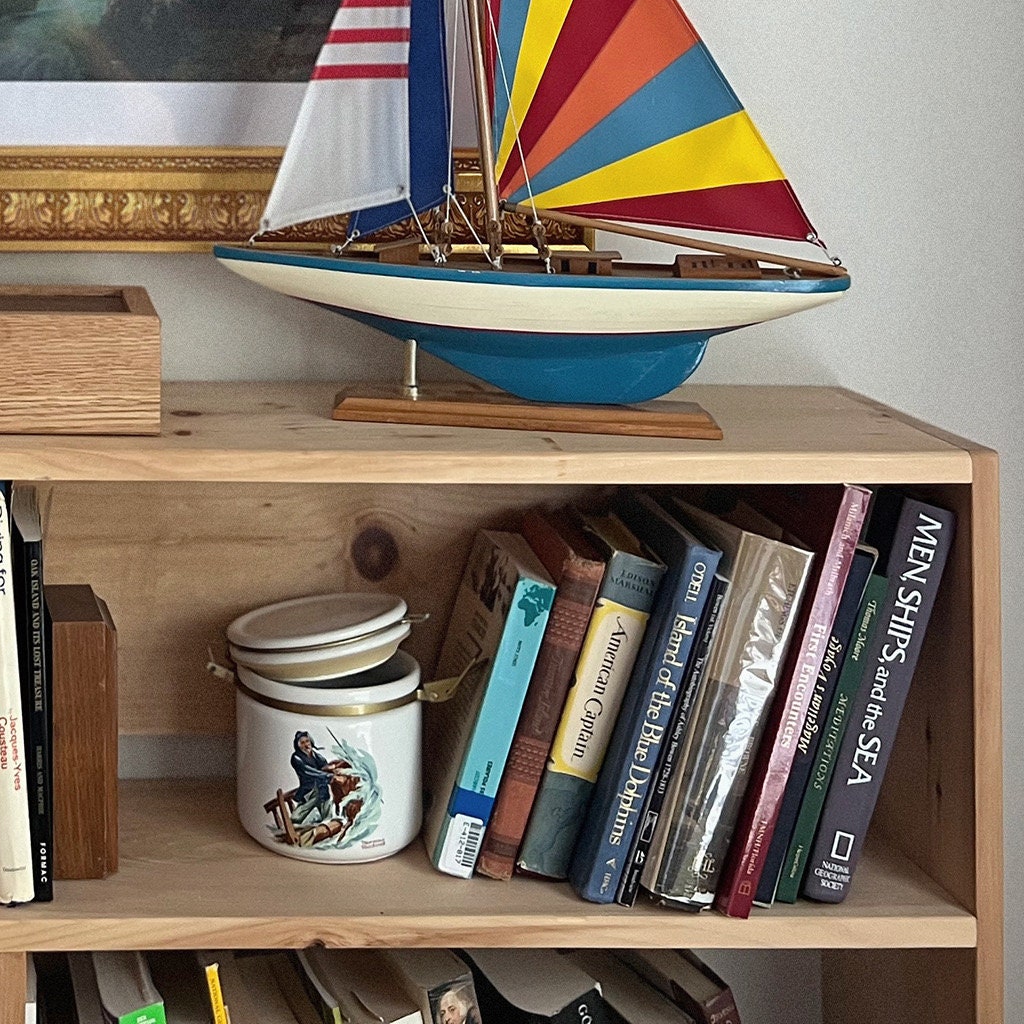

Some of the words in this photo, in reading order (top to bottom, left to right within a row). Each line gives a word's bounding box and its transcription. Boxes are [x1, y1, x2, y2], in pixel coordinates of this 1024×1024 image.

[841, 502, 859, 542] Milanich
[30, 559, 38, 576] OAK
[836, 542, 848, 558] and
[902, 512, 943, 583] MEN,
[31, 579, 39, 608] ISLAND
[32, 611, 40, 628] AND
[862, 600, 877, 632] Thomas
[879, 585, 923, 664] SHIPS,
[32, 630, 41, 644] ITS
[33, 646, 41, 666] LOST
[593, 615, 629, 696] American
[674, 612, 698, 667] Island
[805, 622, 828, 658] First
[851, 632, 867, 661] Moore
[33, 669, 43, 711] TREASURE
[658, 667, 677, 692] of
[679, 669, 700, 711] Autobiography
[796, 682, 826, 755] Magellan's
[818, 634, 843, 684] Voyage
[870, 666, 890, 699] and
[646, 693, 673, 720] the
[780, 661, 818, 750] Encounters
[861, 699, 884, 733] the
[572, 696, 604, 760] Captain
[635, 720, 665, 762] Blue
[814, 692, 849, 791] MEDITATIONS
[9, 715, 21, 791] Jacques-Yves
[846, 734, 882, 787] SEA
[609, 763, 651, 847] Dolphins
[39, 842, 48, 883] FORMAC
[821, 861, 850, 874] NATIONAL
[820, 878, 845, 891] SOCIETY
